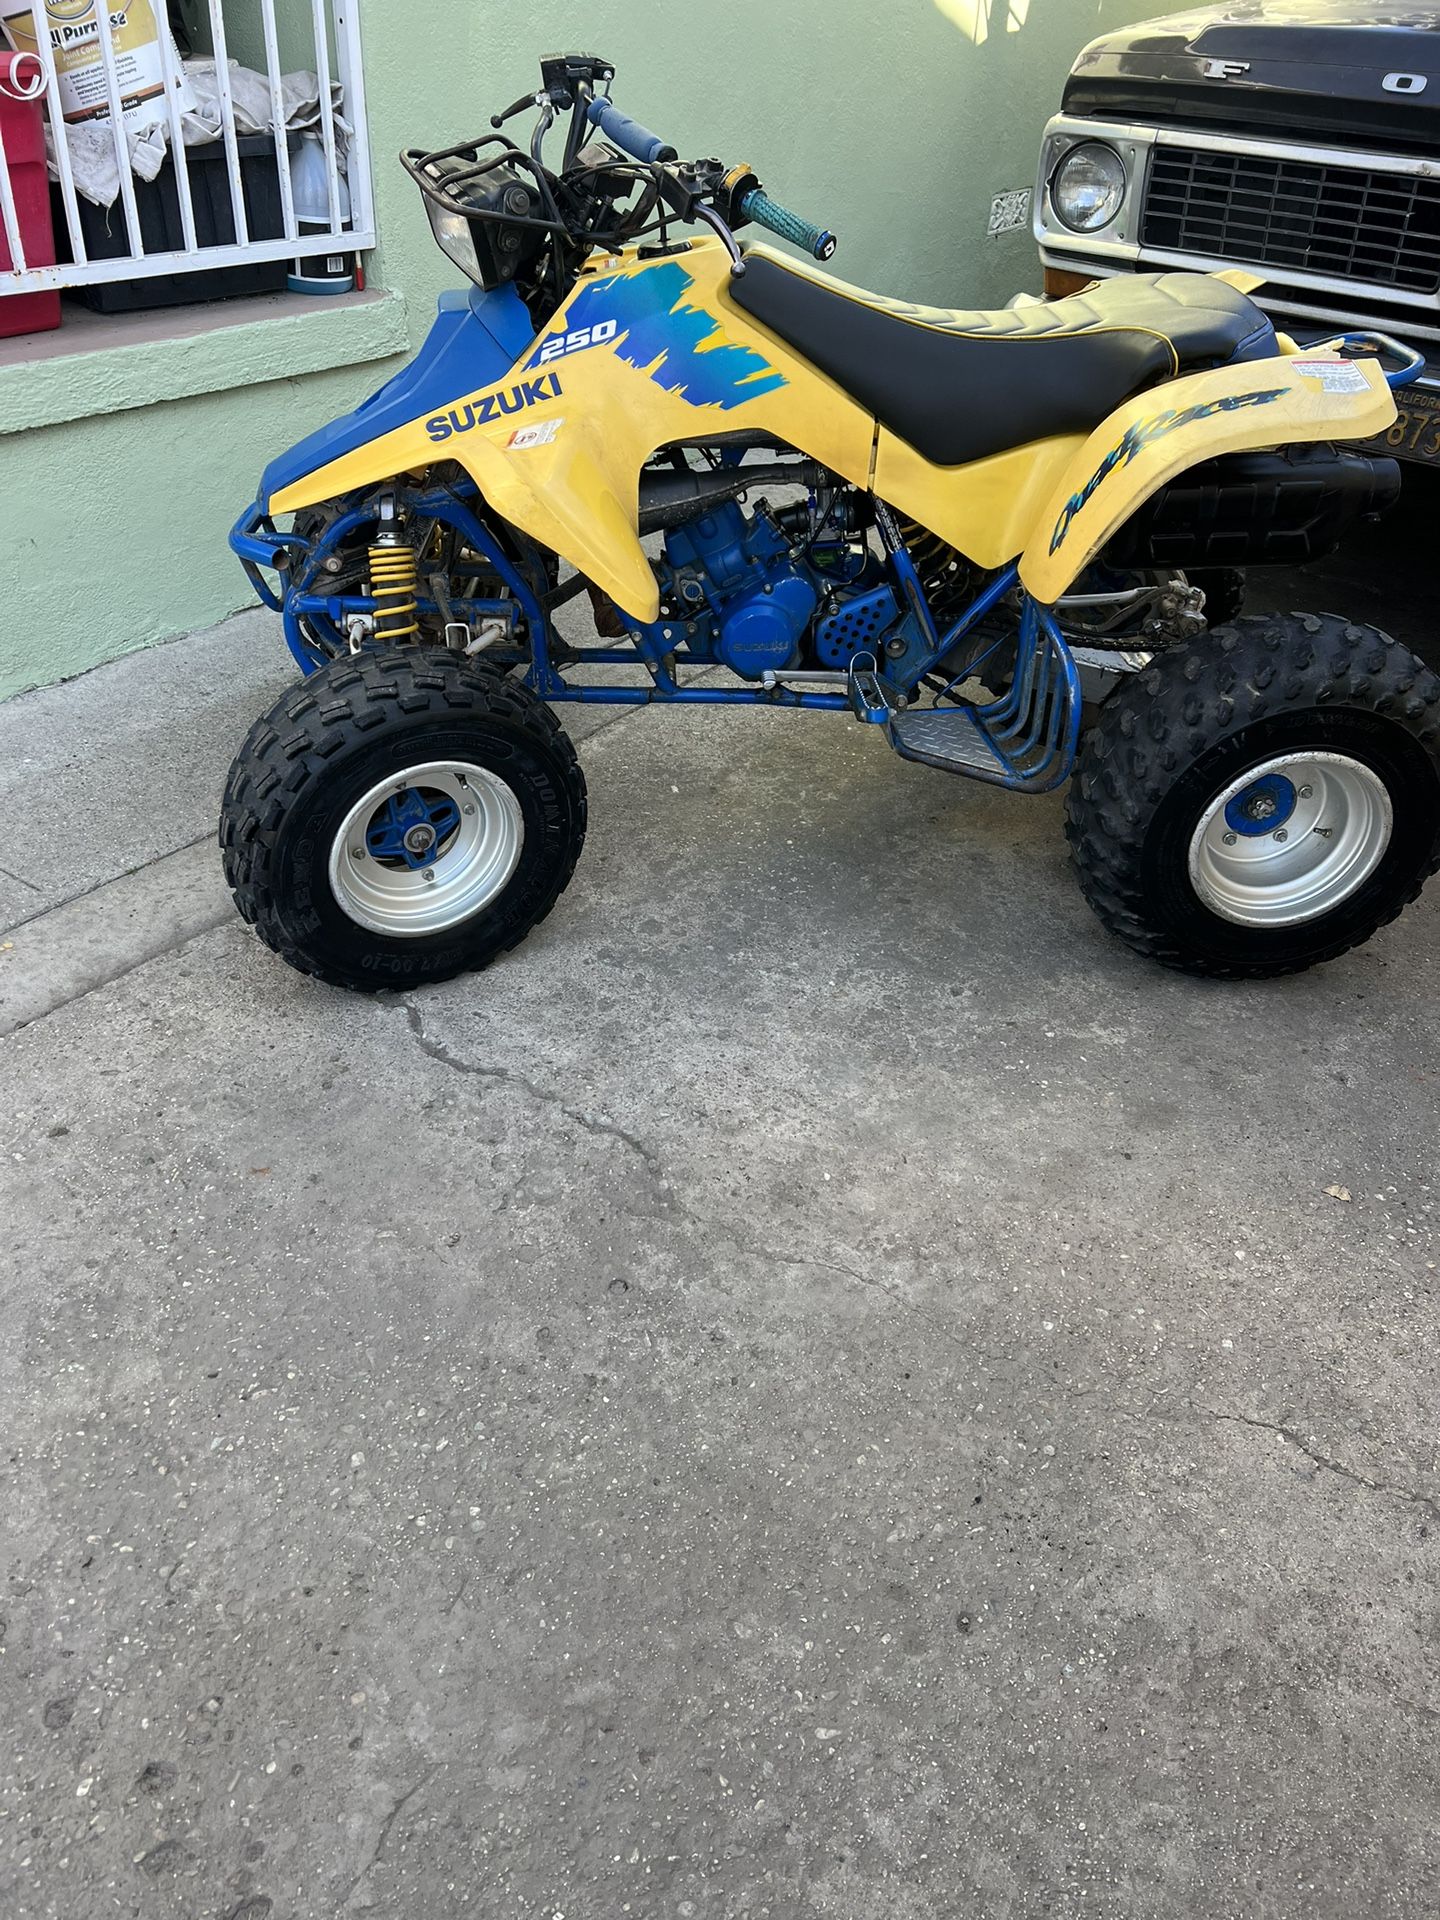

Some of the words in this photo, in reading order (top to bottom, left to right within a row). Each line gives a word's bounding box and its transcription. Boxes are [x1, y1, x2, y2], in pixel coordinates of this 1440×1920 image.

[49, 28, 61, 48] ll
[62, 12, 126, 41] Purpse
[540, 319, 617, 361] 250
[425, 372, 564, 442] SUZUKI
[1392, 390, 1440, 411] ALIFOR
[1364, 410, 1440, 454] 873
